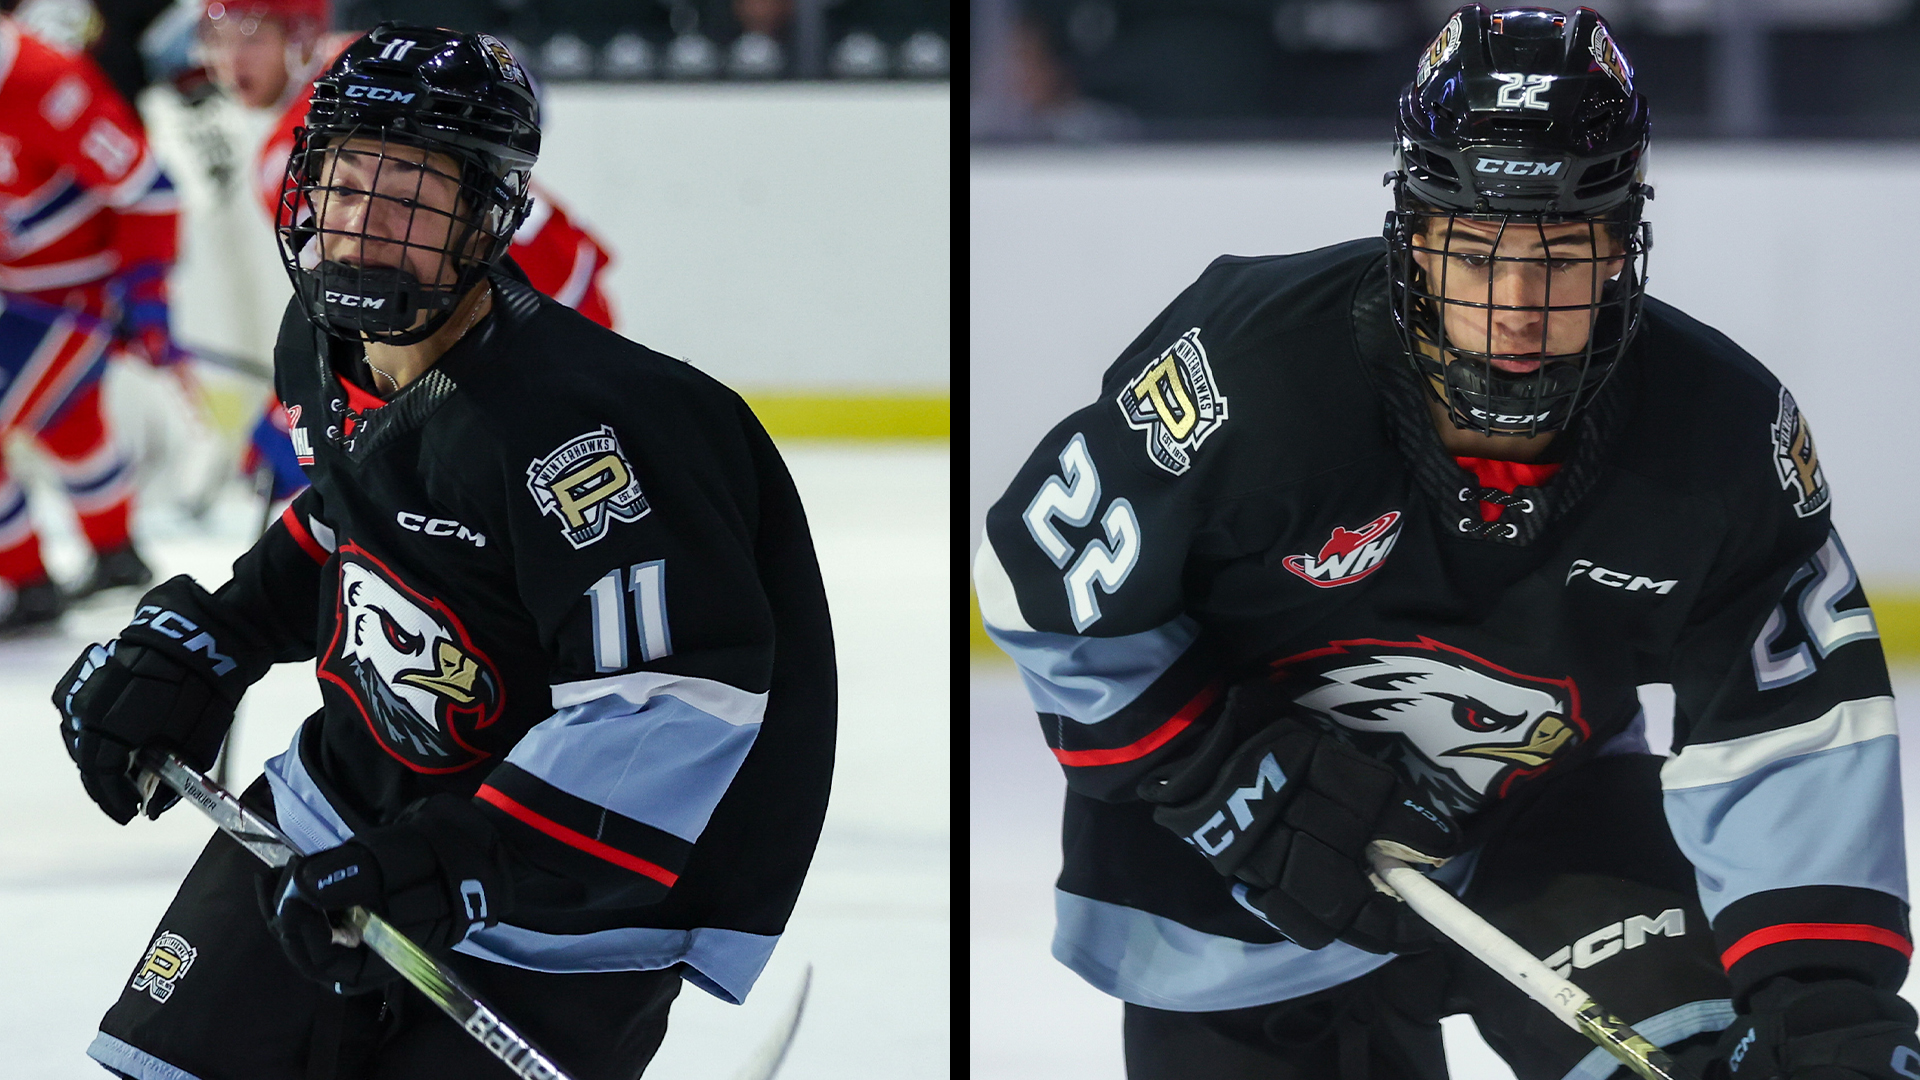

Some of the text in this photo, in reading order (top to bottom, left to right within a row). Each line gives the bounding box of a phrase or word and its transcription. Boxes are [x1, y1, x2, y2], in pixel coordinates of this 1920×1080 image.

[379, 39, 417, 61] 11
[345, 85, 416, 104] CCM
[1497, 72, 1552, 110] 22
[1475, 158, 1562, 176] CCM
[325, 290, 385, 310] CCM
[1176, 341, 1212, 410] WINTERHAWKS
[1134, 354, 1196, 439] P
[1470, 406, 1551, 423] CCM
[539, 439, 610, 482] WINTERHAWKS
[550, 455, 628, 528] P
[396, 511, 486, 547] CCM
[1022, 432, 1141, 634] 22
[1304, 530, 1402, 580] WH
[1566, 559, 1678, 595] CCM
[584, 559, 672, 673] 11
[1750, 528, 1880, 691] 22
[129, 605, 238, 677] CCM
[1183, 752, 1287, 857] CM
[1403, 799, 1450, 833] CCM
[1554, 987, 1577, 1007] 22
